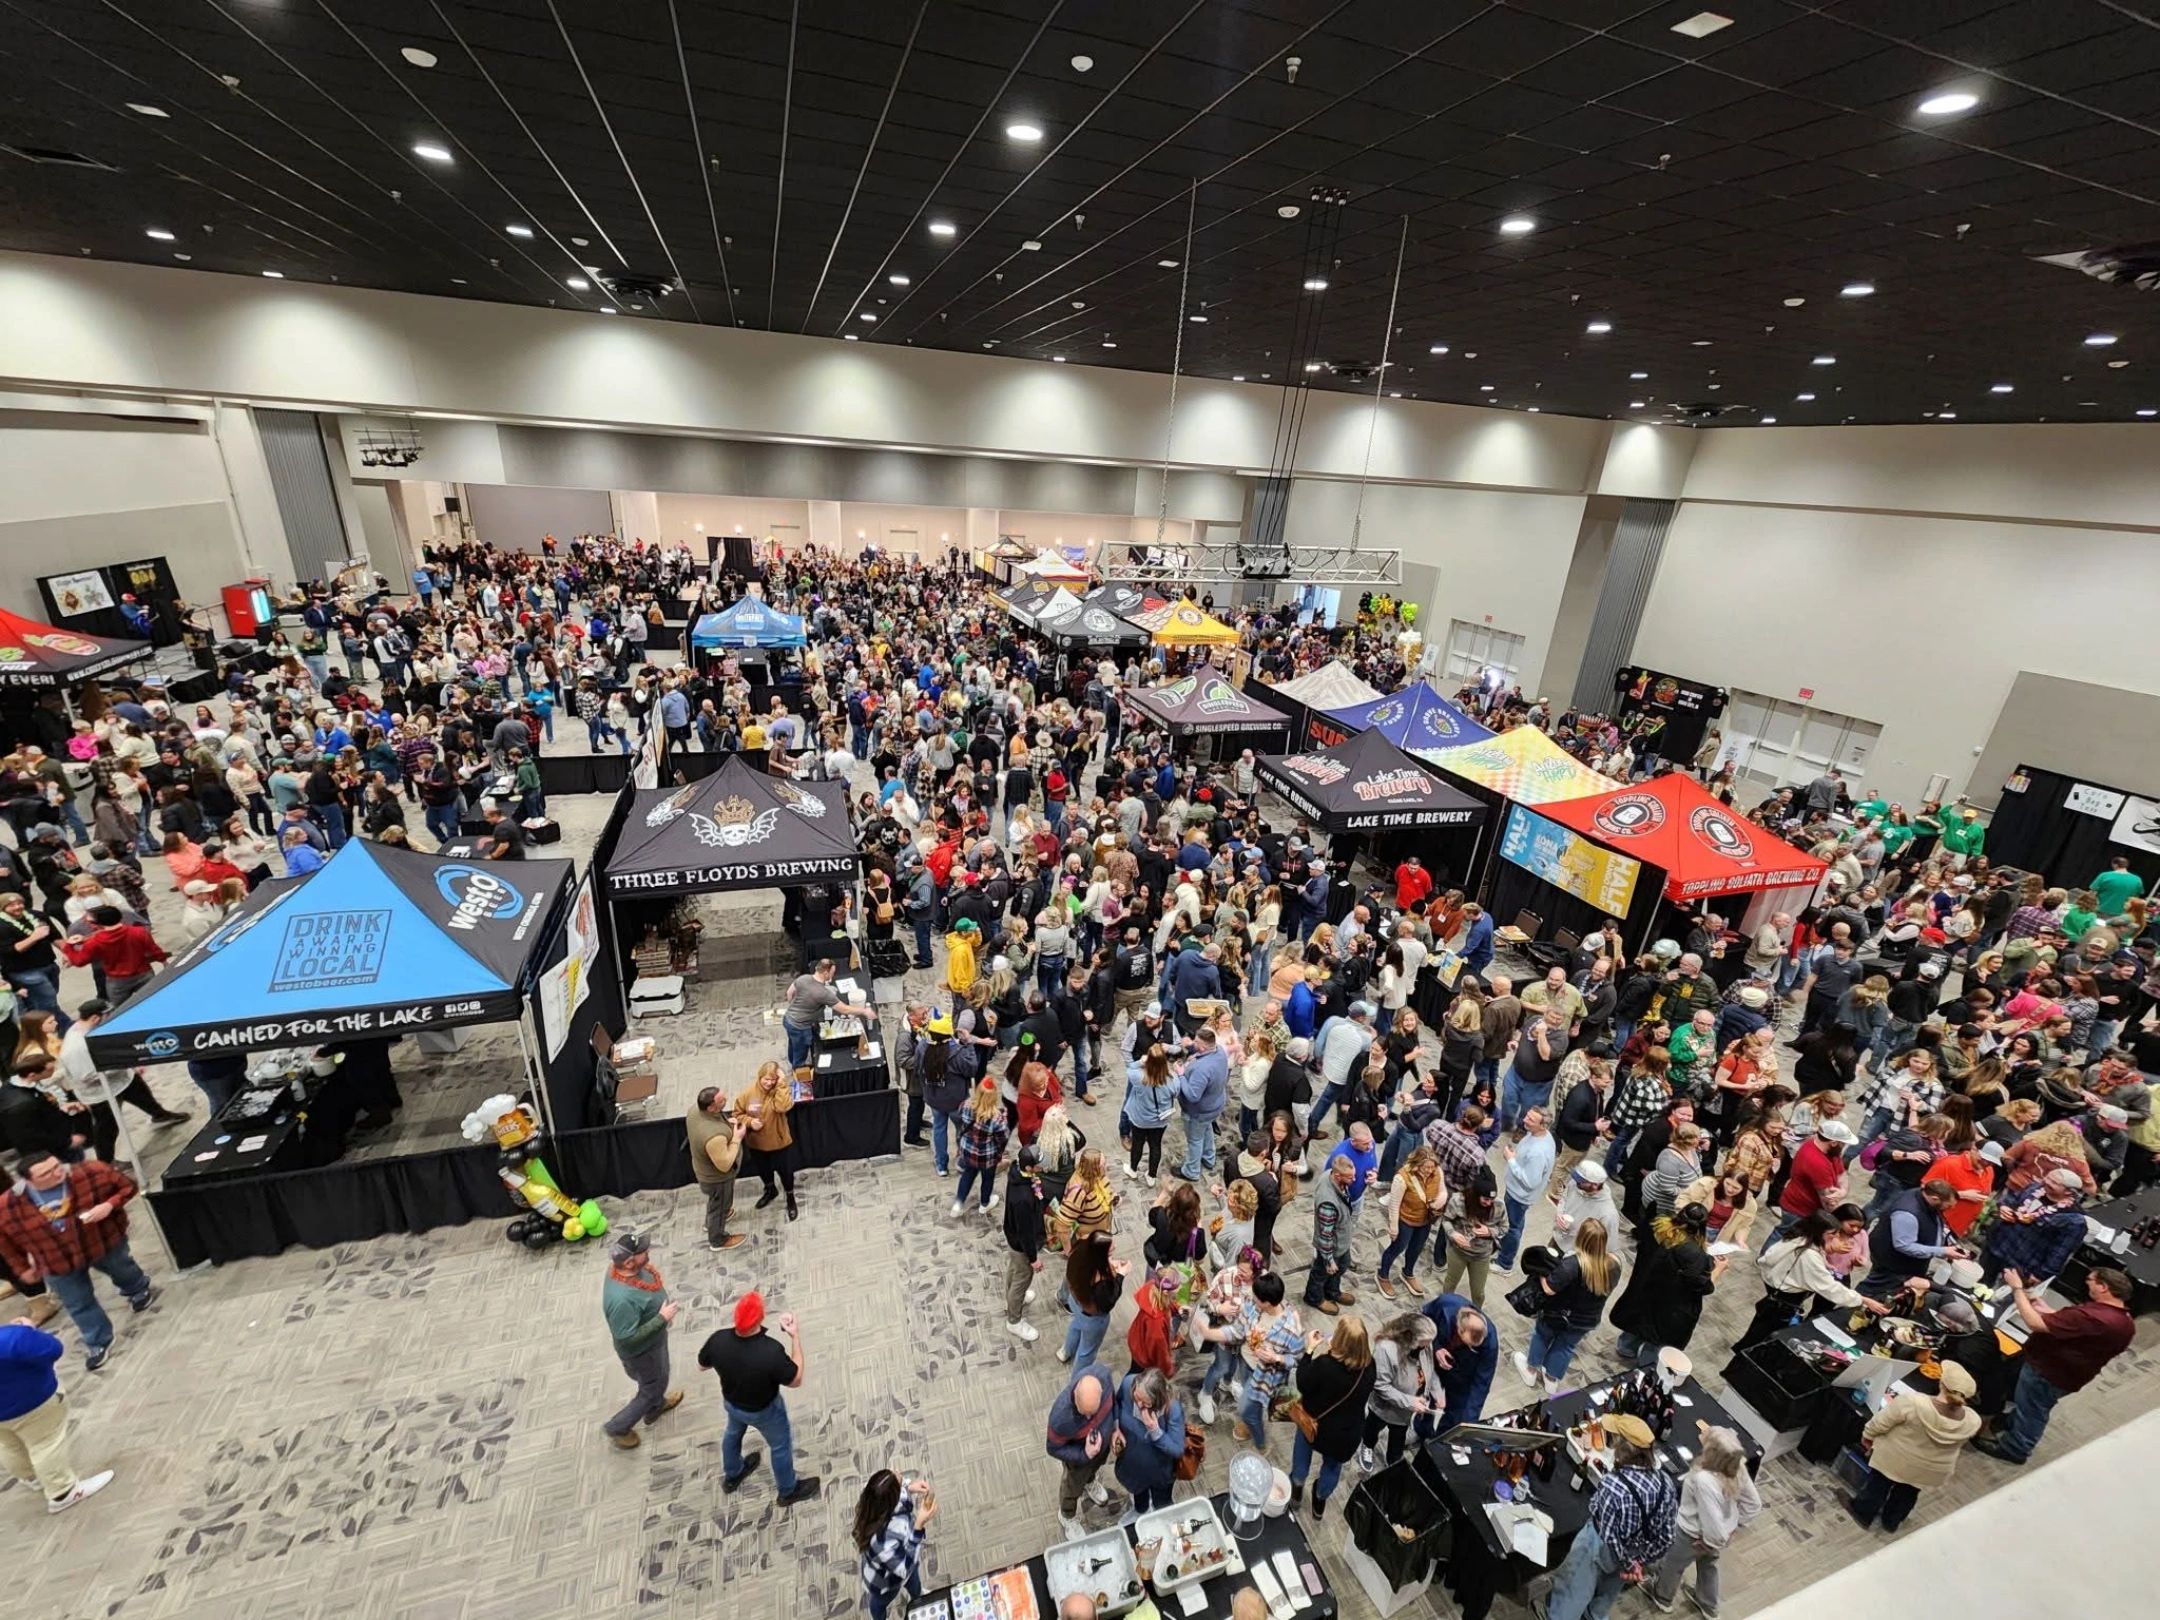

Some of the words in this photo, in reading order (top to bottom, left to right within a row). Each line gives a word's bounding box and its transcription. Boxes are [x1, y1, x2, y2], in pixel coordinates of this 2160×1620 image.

[1195, 723, 1240, 733] SINGLESPEED
[1353, 776, 1433, 801] Brewery
[1367, 770, 1394, 785] Lake
[1394, 768, 1421, 781] Time
[1259, 768, 1275, 785] LAKE
[1275, 778, 1291, 798] TIME
[1290, 788, 1323, 822] BREWERY
[1614, 794, 1651, 806] TOPPLING
[1347, 812, 1379, 828] LAKE
[1383, 811, 1413, 826] TIME
[1416, 810, 1473, 825] BREWERY
[1503, 808, 1526, 857] HALF
[610, 871, 679, 889] THREE
[685, 864, 759, 884] FLOYDS
[765, 858, 853, 877] BREWING
[1608, 854, 1640, 916] HALF
[1681, 878, 1726, 896] TOPPLING
[1726, 872, 1763, 889] GOLIATH
[1765, 869, 1804, 885] BREWING
[293, 913, 383, 938] DRINK
[289, 943, 377, 960] WINNING
[295, 933, 375, 949] AWARD
[281, 953, 374, 980] LOCAL
[274, 976, 374, 991] westobeer.com
[193, 1023, 283, 1050] CANNED
[285, 1019, 333, 1038] FOR
[333, 1012, 372, 1032] THE
[379, 1005, 434, 1028] LAKE
